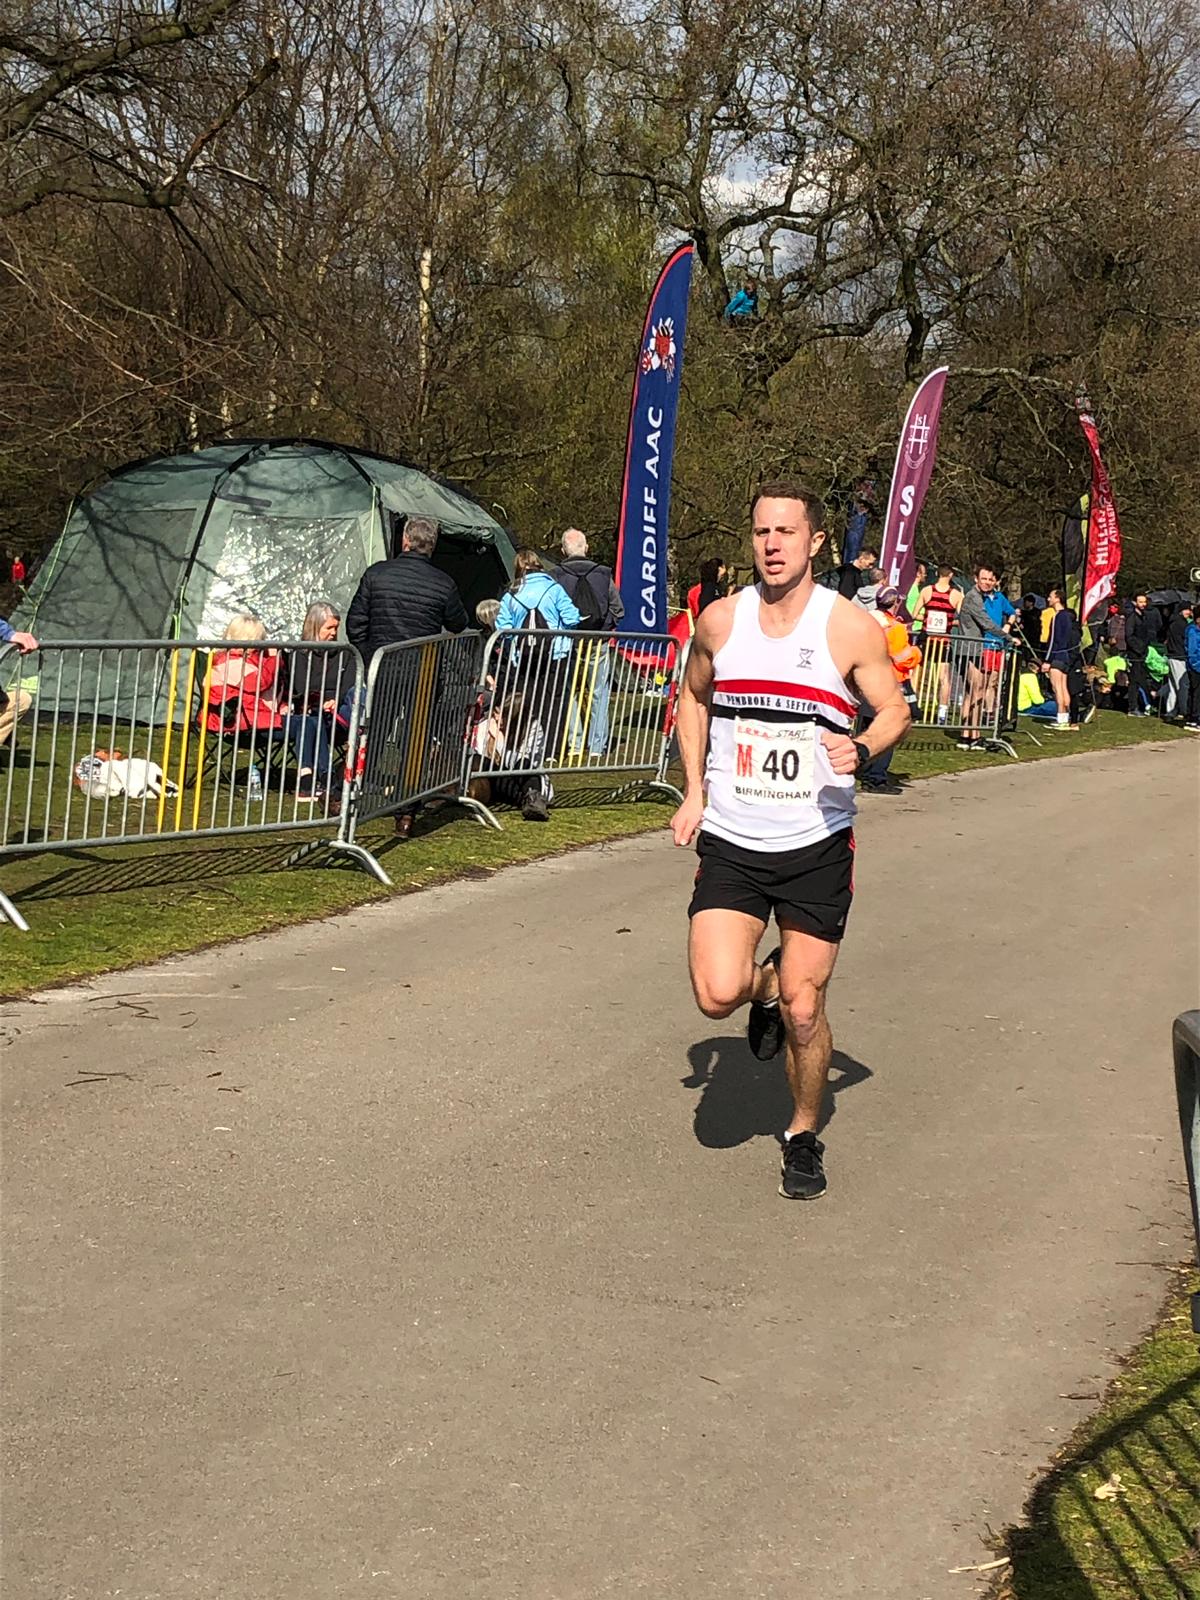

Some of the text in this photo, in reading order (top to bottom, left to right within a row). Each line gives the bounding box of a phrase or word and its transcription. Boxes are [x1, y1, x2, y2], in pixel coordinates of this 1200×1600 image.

[641, 406, 663, 628] CARDIFF AAC
[726, 694, 818, 712] PEMBROKE & SEFTON
[776, 729, 808, 739] START
[737, 743, 800, 781] M 40
[735, 785, 812, 800] BIRMINGHAM
